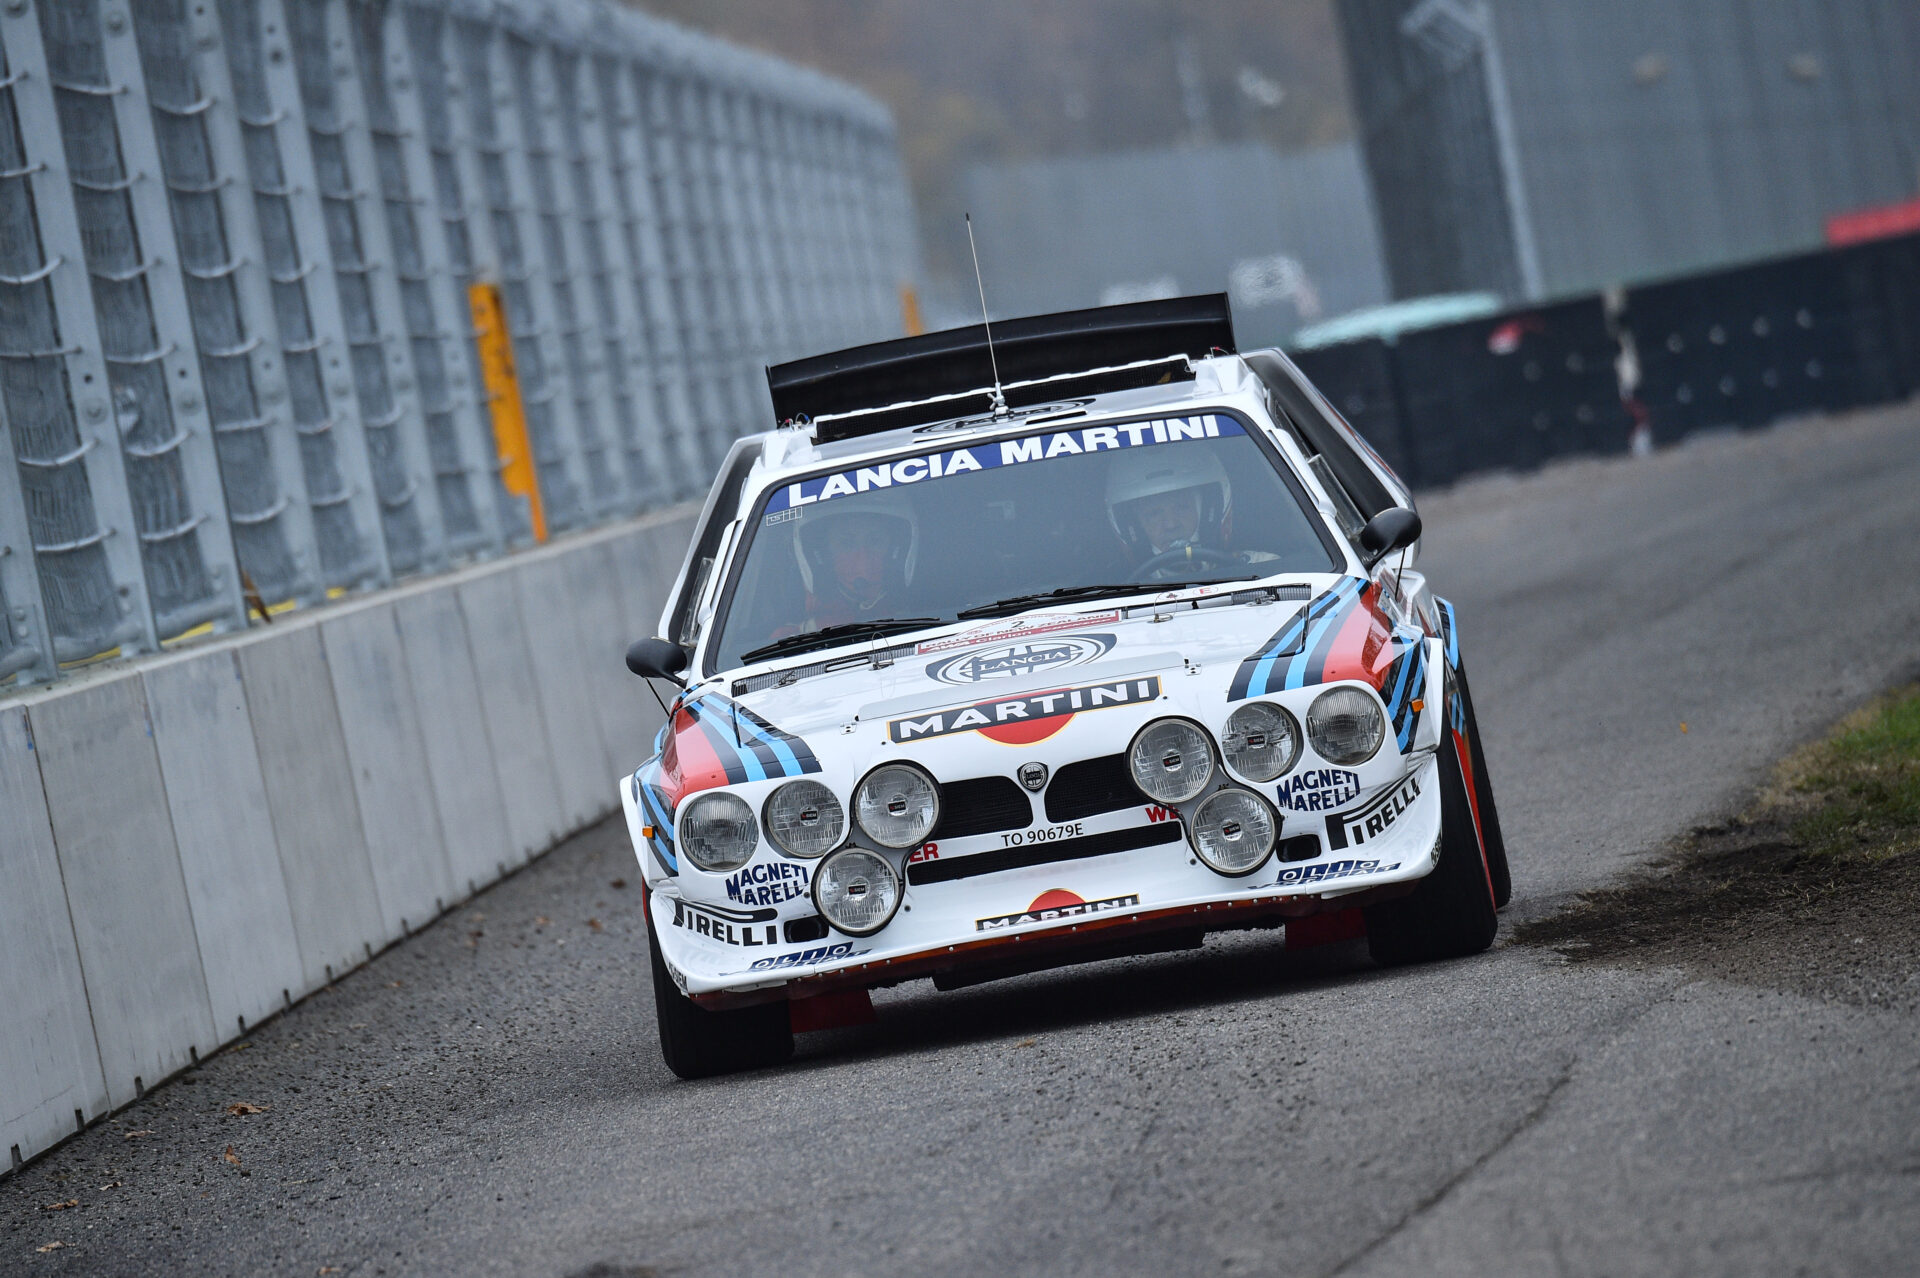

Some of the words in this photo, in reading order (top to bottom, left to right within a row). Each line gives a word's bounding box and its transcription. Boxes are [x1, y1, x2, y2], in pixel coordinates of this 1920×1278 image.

[789, 447, 984, 507] LANCIA
[1001, 414, 1220, 464] MARTINI
[1011, 620, 1025, 629] 2
[978, 651, 1067, 671] LANCIA
[899, 679, 1150, 739] MARTINI
[1276, 769, 1360, 799] MAGNETI
[1324, 764, 1423, 851] PIRELLI
[1001, 832, 1023, 848] TO
[1029, 822, 1084, 844] 90679E
[725, 863, 809, 896] MAGNETI
[1282, 860, 1375, 881] OLIO
[672, 897, 778, 947] PIRELLI
[982, 897, 1133, 931] MARTINI
[754, 944, 848, 969] OLIO
